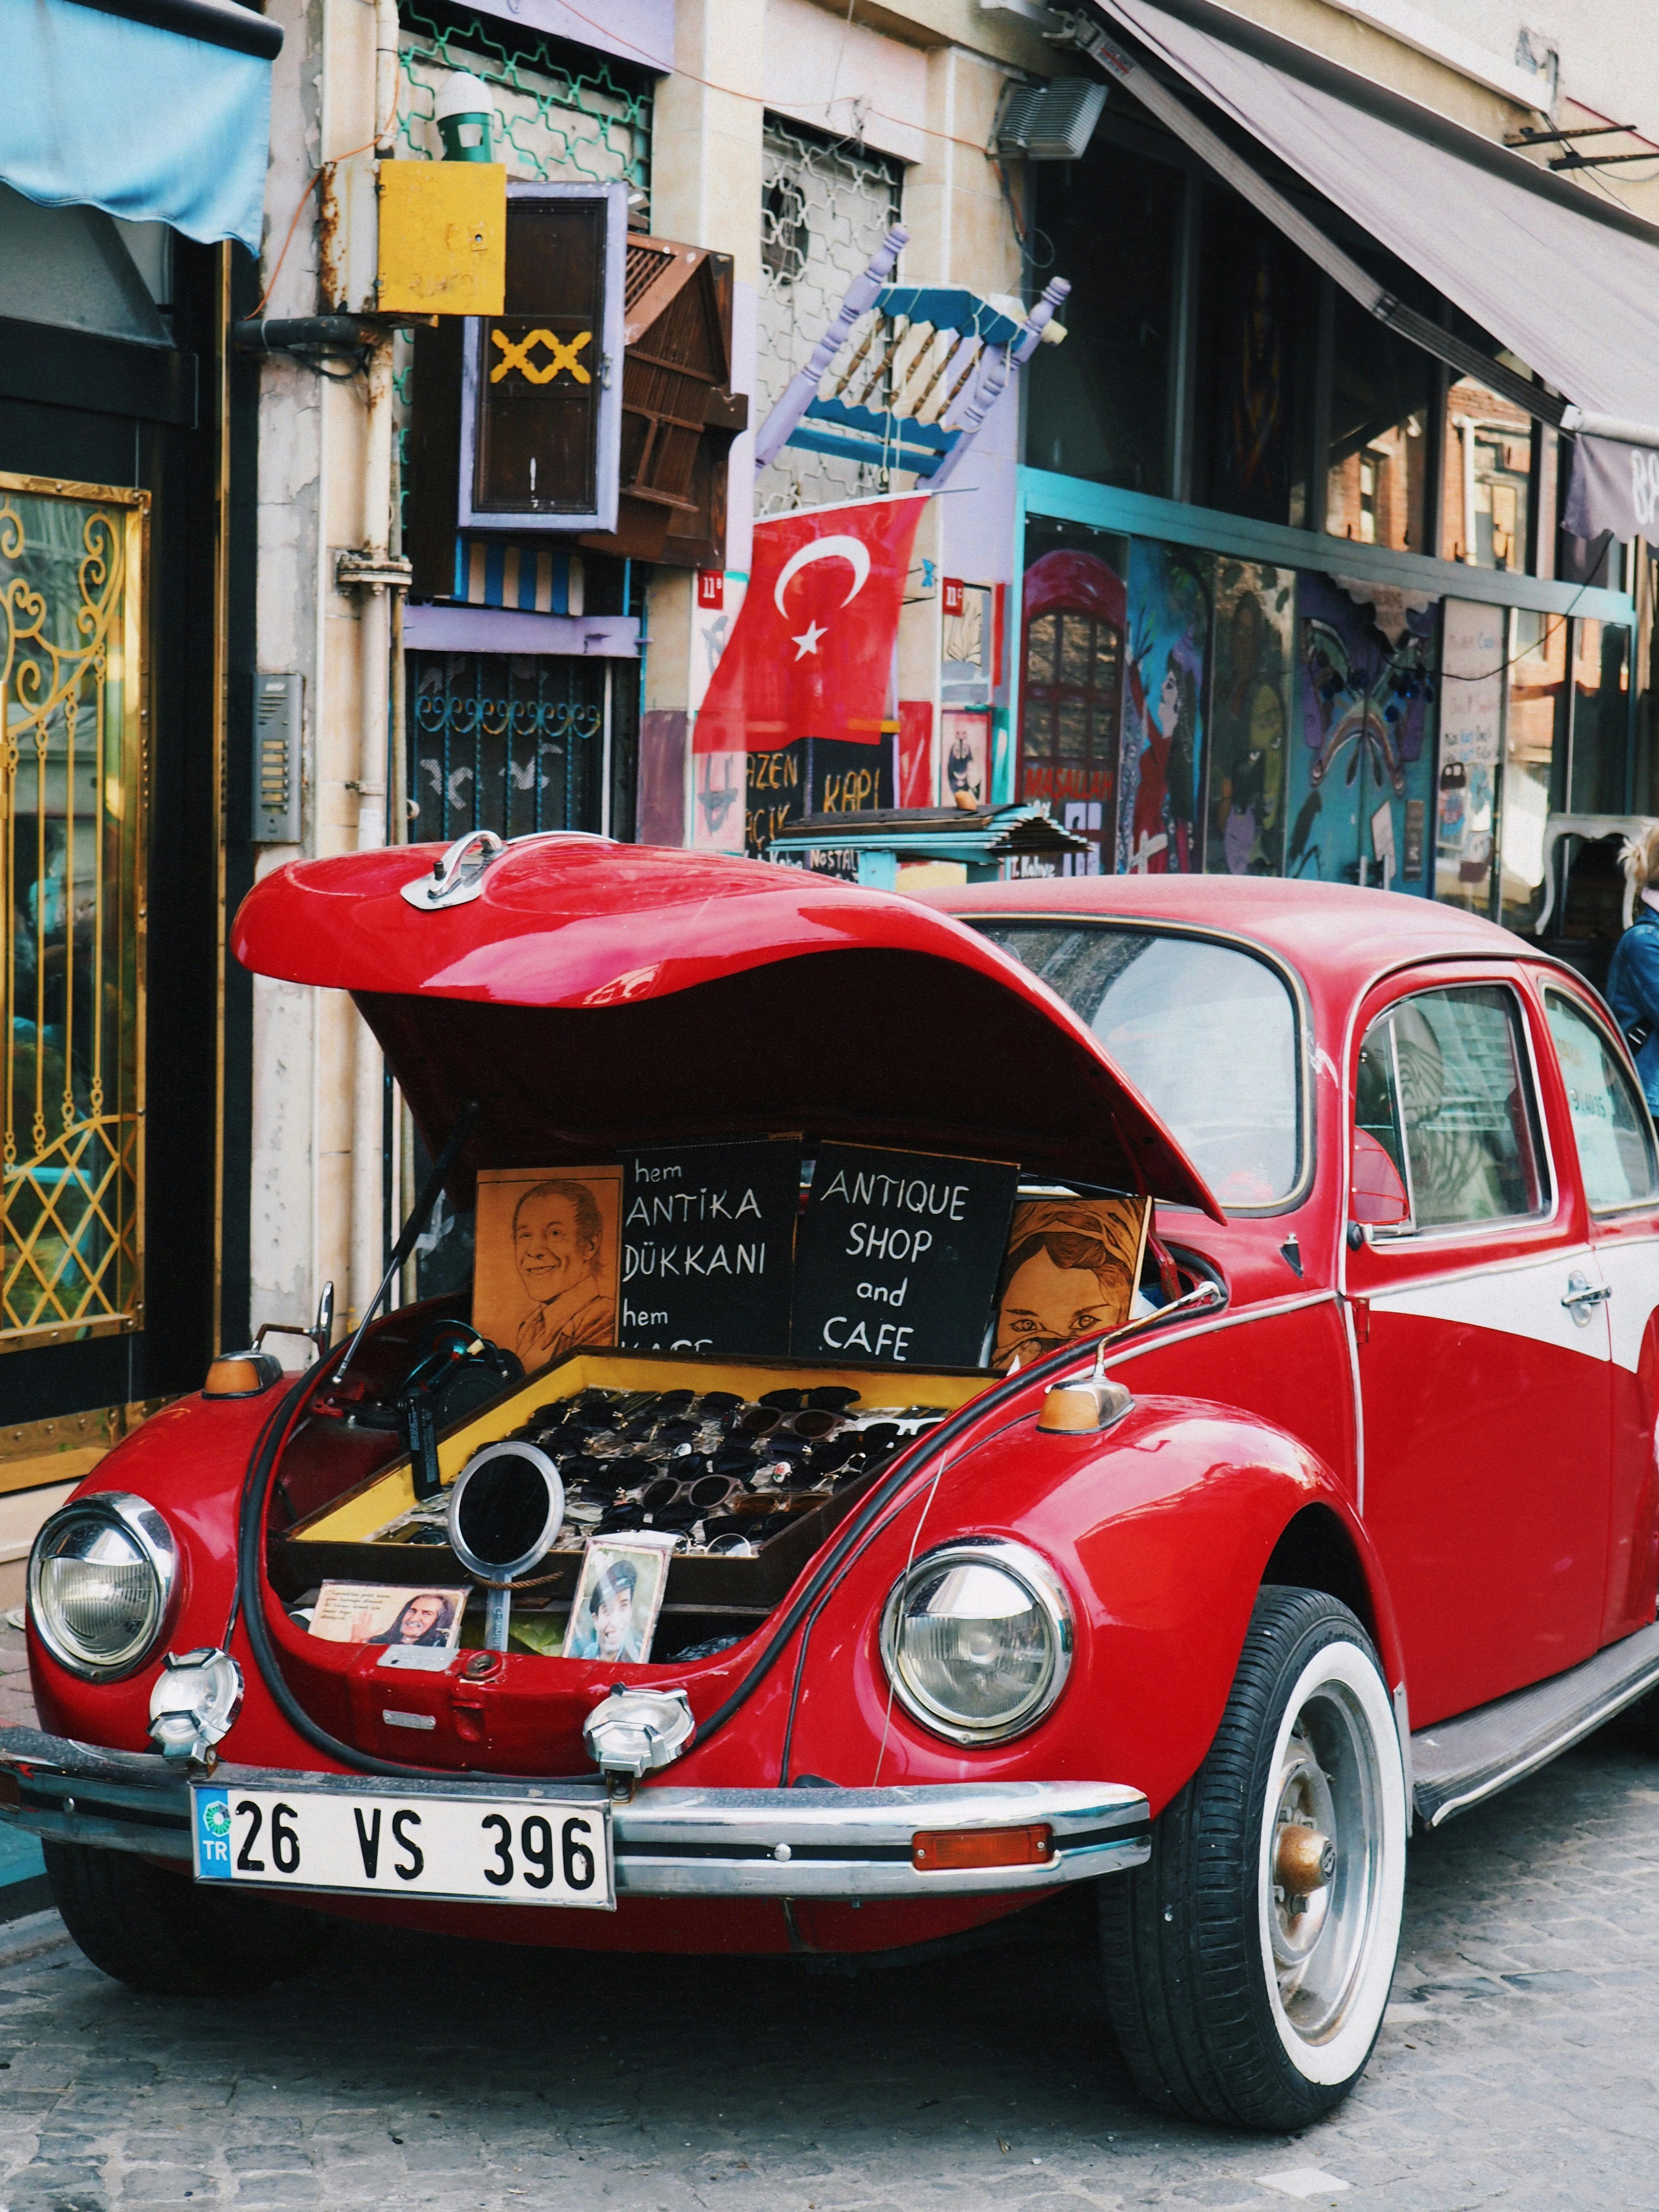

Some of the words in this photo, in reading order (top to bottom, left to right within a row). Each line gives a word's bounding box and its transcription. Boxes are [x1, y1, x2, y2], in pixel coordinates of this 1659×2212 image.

[1023, 768, 1114, 807] MAŞALLAH
[636, 1158, 682, 1182] hem
[625, 1188, 762, 1227] ANTİKA
[820, 1169, 970, 1221] ANTIQUE
[622, 1241, 765, 1282] DÜKKANI
[845, 1222, 933, 1263] SHOP
[856, 1277, 908, 1307] and
[623, 1298, 668, 1327] hem
[823, 1316, 914, 1361] CAFE
[202, 1840, 228, 1862] TR
[235, 1800, 301, 1874] 26
[354, 1807, 424, 1880] VS
[481, 1813, 596, 1890] 396
